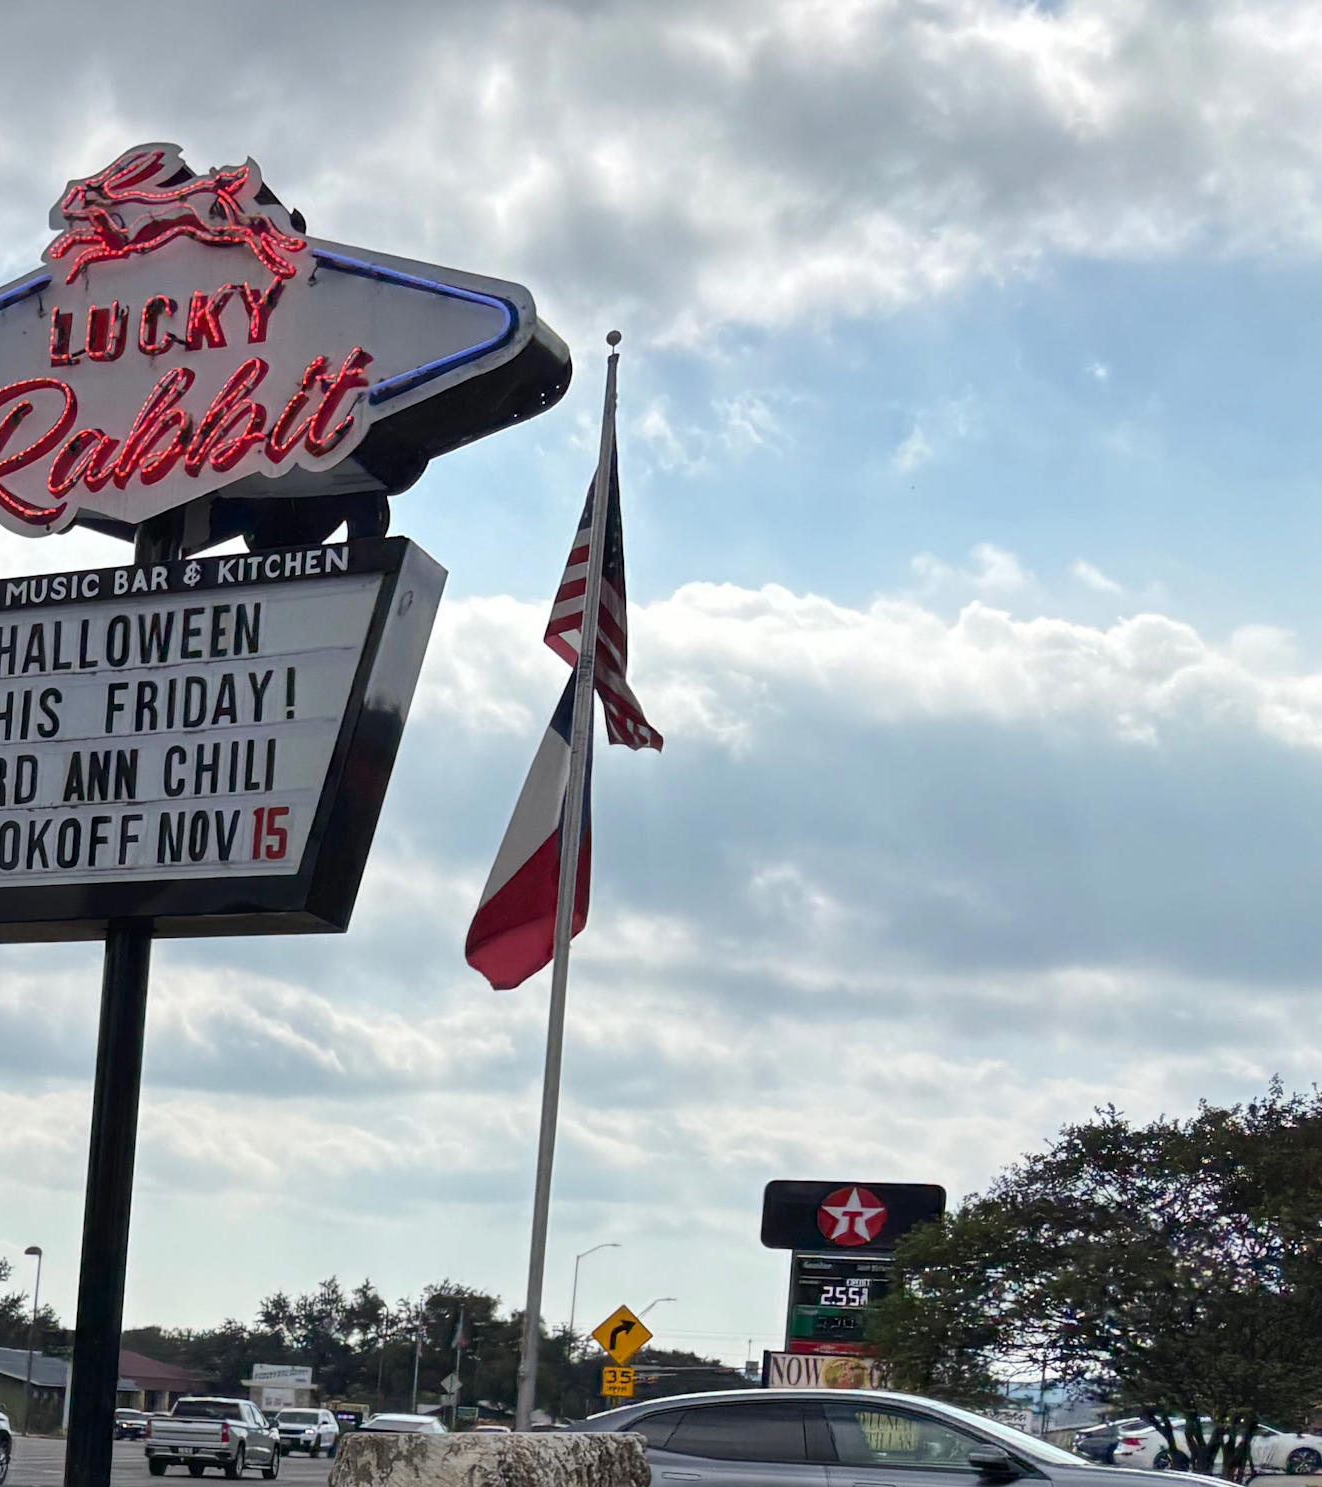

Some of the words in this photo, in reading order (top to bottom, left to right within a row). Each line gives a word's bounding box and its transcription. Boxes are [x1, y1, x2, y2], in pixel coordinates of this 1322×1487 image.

[50, 275, 284, 367] LUCKY
[5, 573, 100, 607] MUSIC
[113, 566, 168, 595] BAR
[182, 561, 202, 587] &
[217, 546, 350, 584] KITCHEN
[105, 666, 296, 734] FRIDAY!
[62, 748, 139, 802] ANN
[163, 738, 277, 797] CHILI
[158, 809, 241, 864] NOV
[251, 806, 290, 860] 15
[605, 1369, 632, 1383] 35
[771, 1356, 825, 1386] NOW
